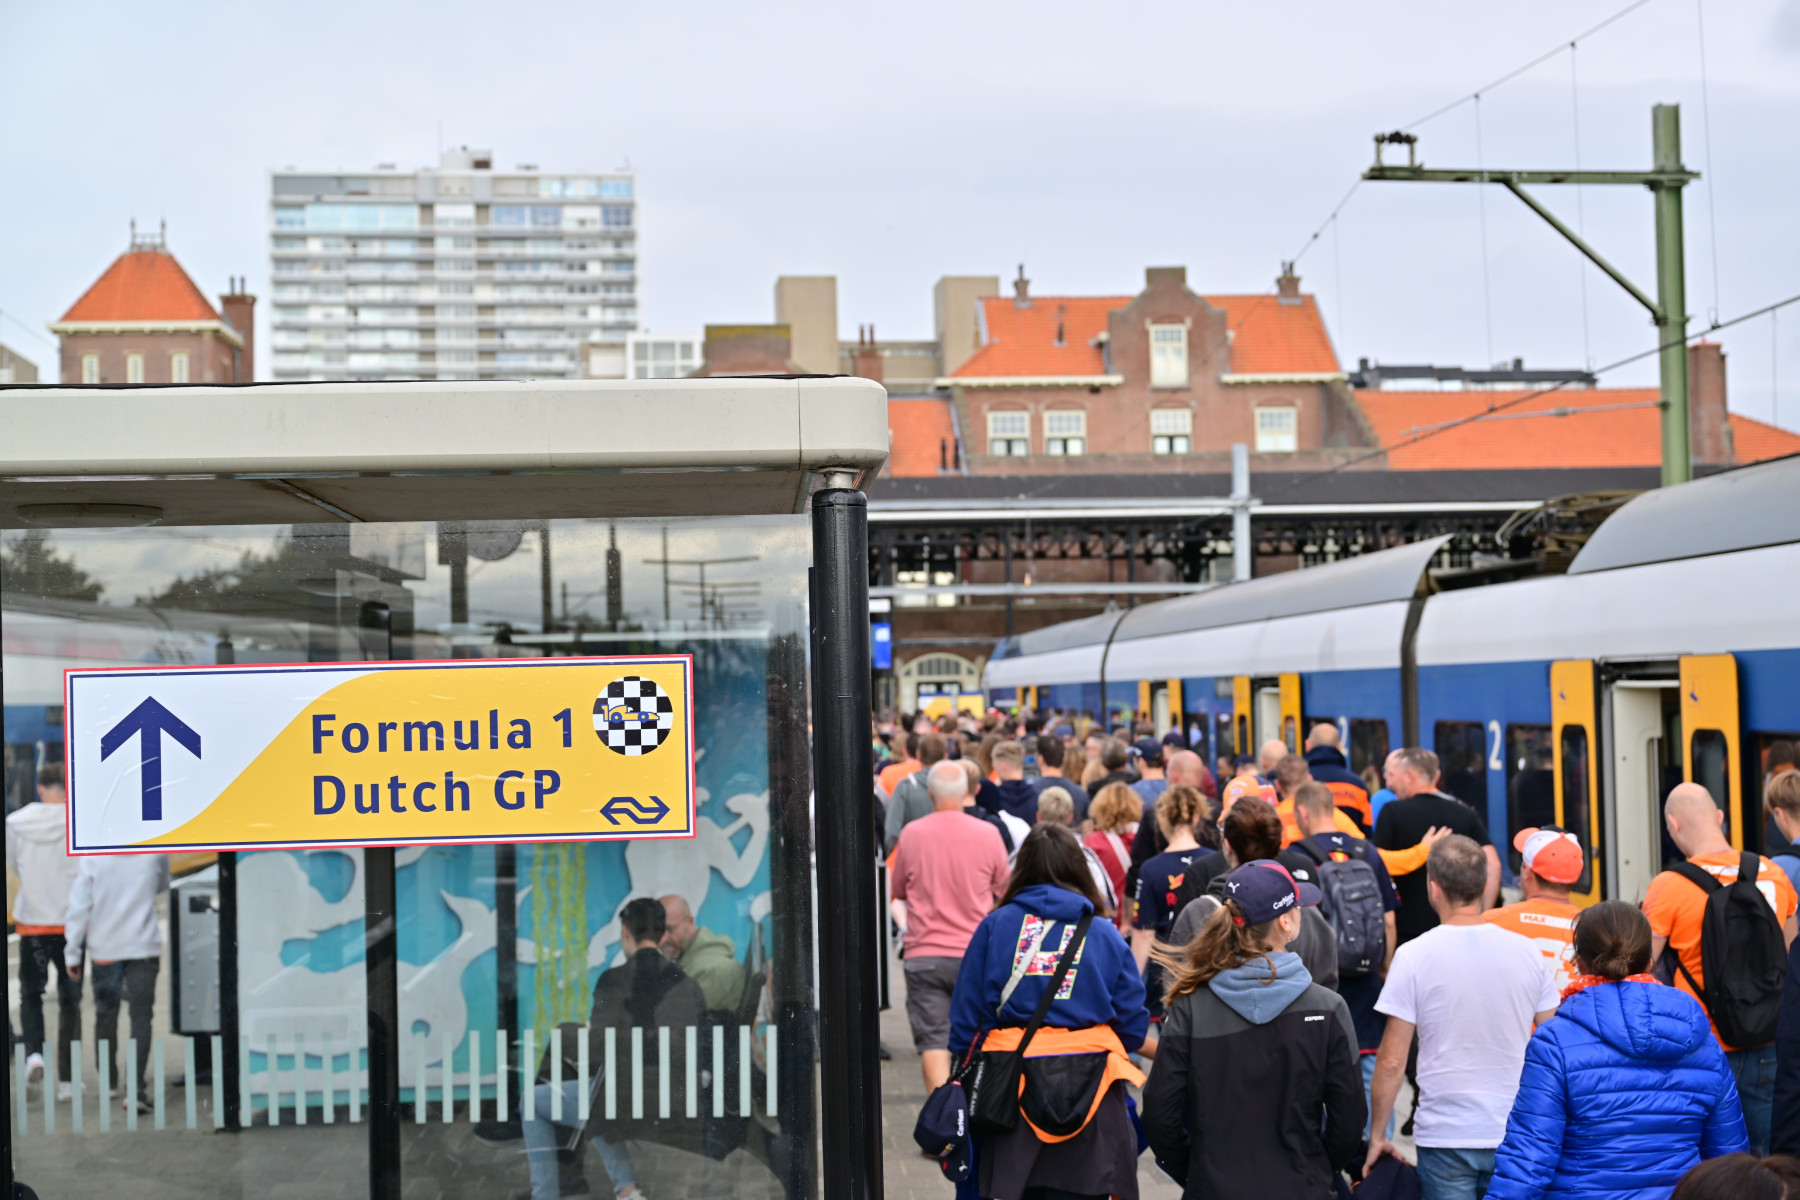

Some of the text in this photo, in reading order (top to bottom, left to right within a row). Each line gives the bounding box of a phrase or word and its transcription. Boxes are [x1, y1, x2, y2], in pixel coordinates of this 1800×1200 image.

[312, 708, 573, 754] Formula 1
[1488, 719, 1503, 770] 2
[312, 769, 562, 815] Dutch GP
[1523, 914, 1547, 923] MAX
